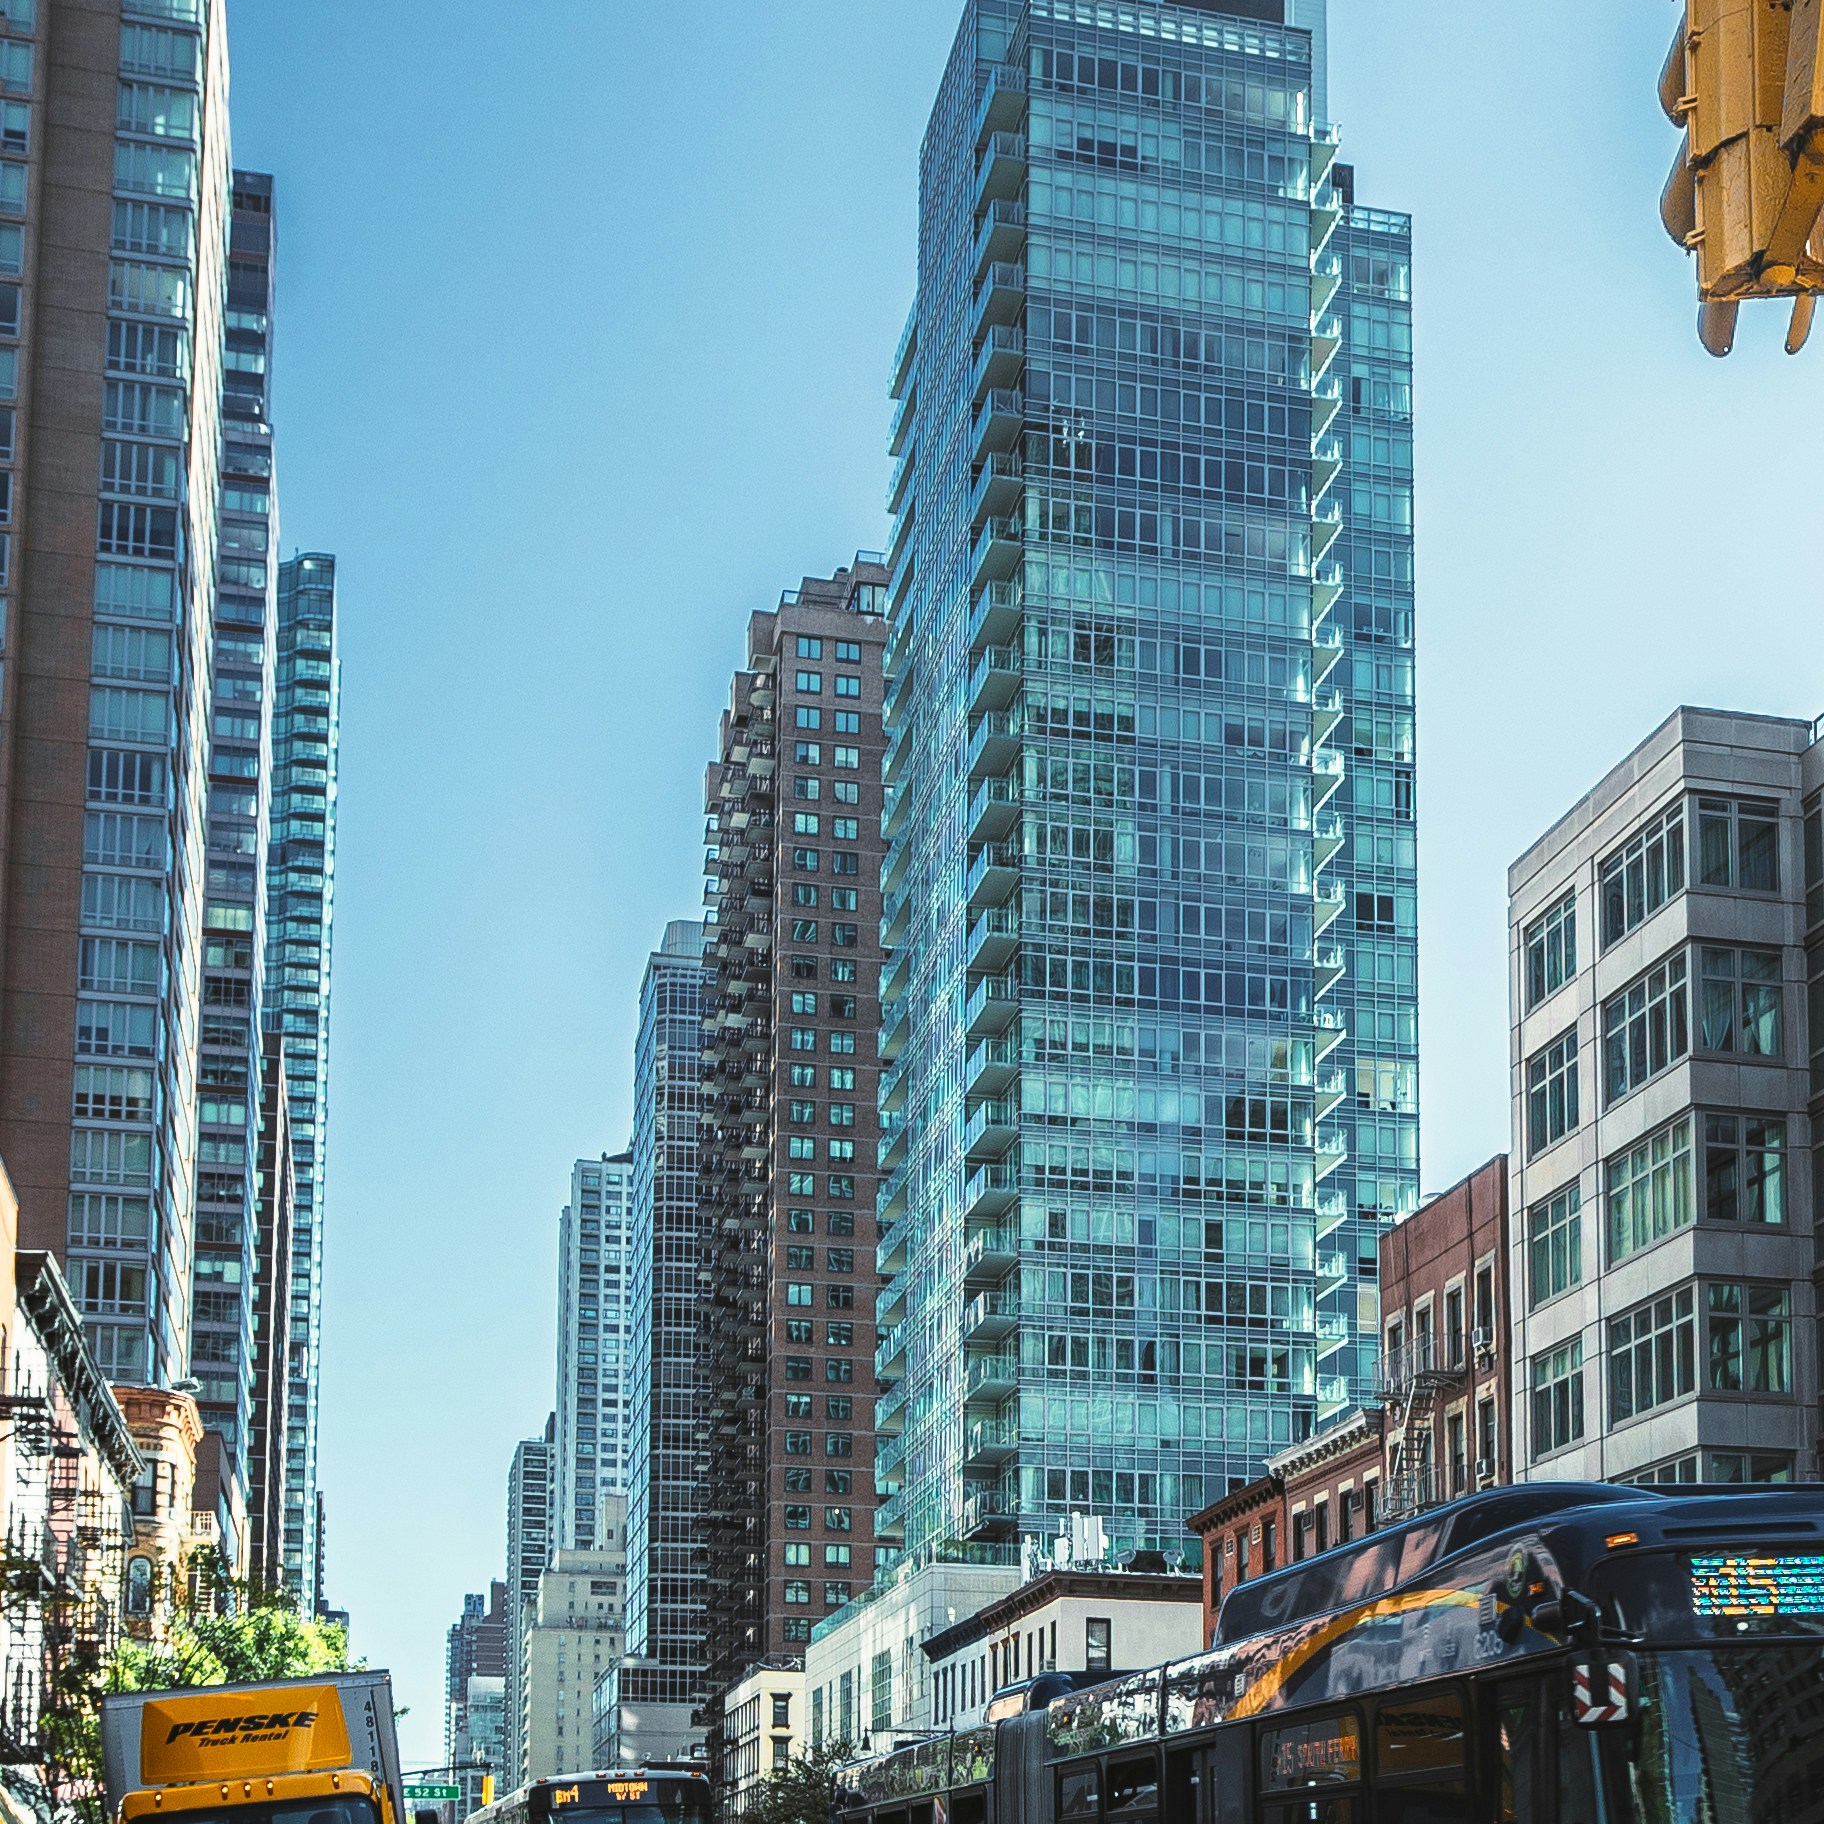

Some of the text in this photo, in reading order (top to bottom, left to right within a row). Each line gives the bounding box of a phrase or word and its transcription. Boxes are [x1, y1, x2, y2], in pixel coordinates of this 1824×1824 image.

[165, 1711, 319, 1746] PENSKE
[197, 1729, 288, 1748] Truck Rental
[403, 1788, 447, 1797] E 52 St
[555, 1784, 579, 1805] BM4
[607, 1781, 649, 1794] MIDTOWN
